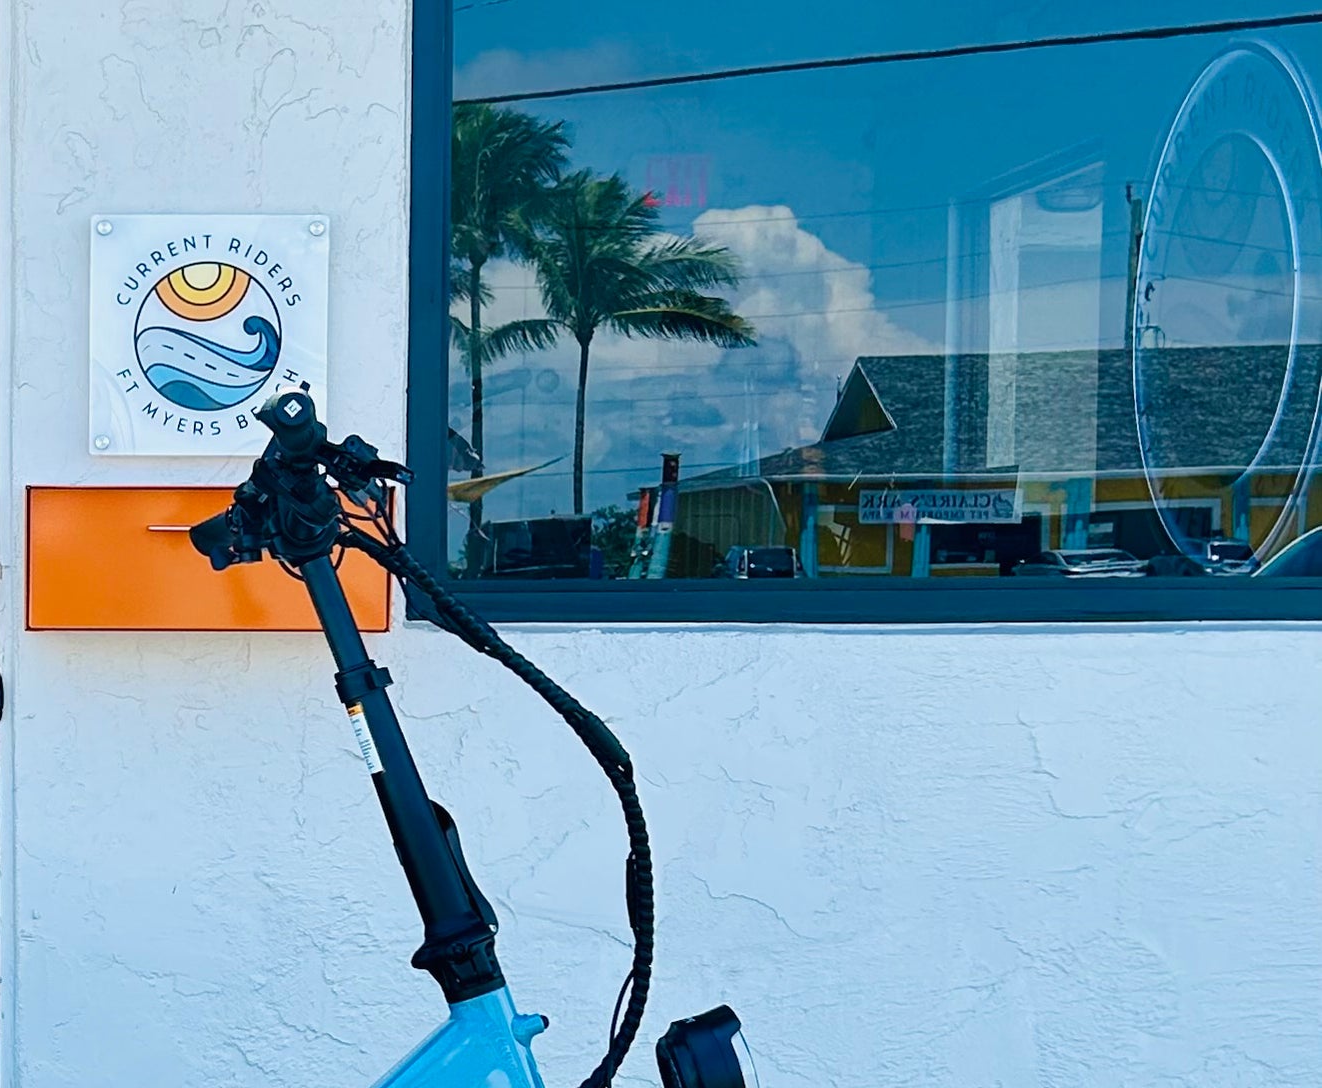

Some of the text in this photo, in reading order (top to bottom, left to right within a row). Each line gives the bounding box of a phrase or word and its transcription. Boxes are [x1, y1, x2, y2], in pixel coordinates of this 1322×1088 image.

[116, 234, 302, 308] CURRENT RIDERS
[116, 367, 140, 394] FT
[141, 401, 222, 436] MYERS
